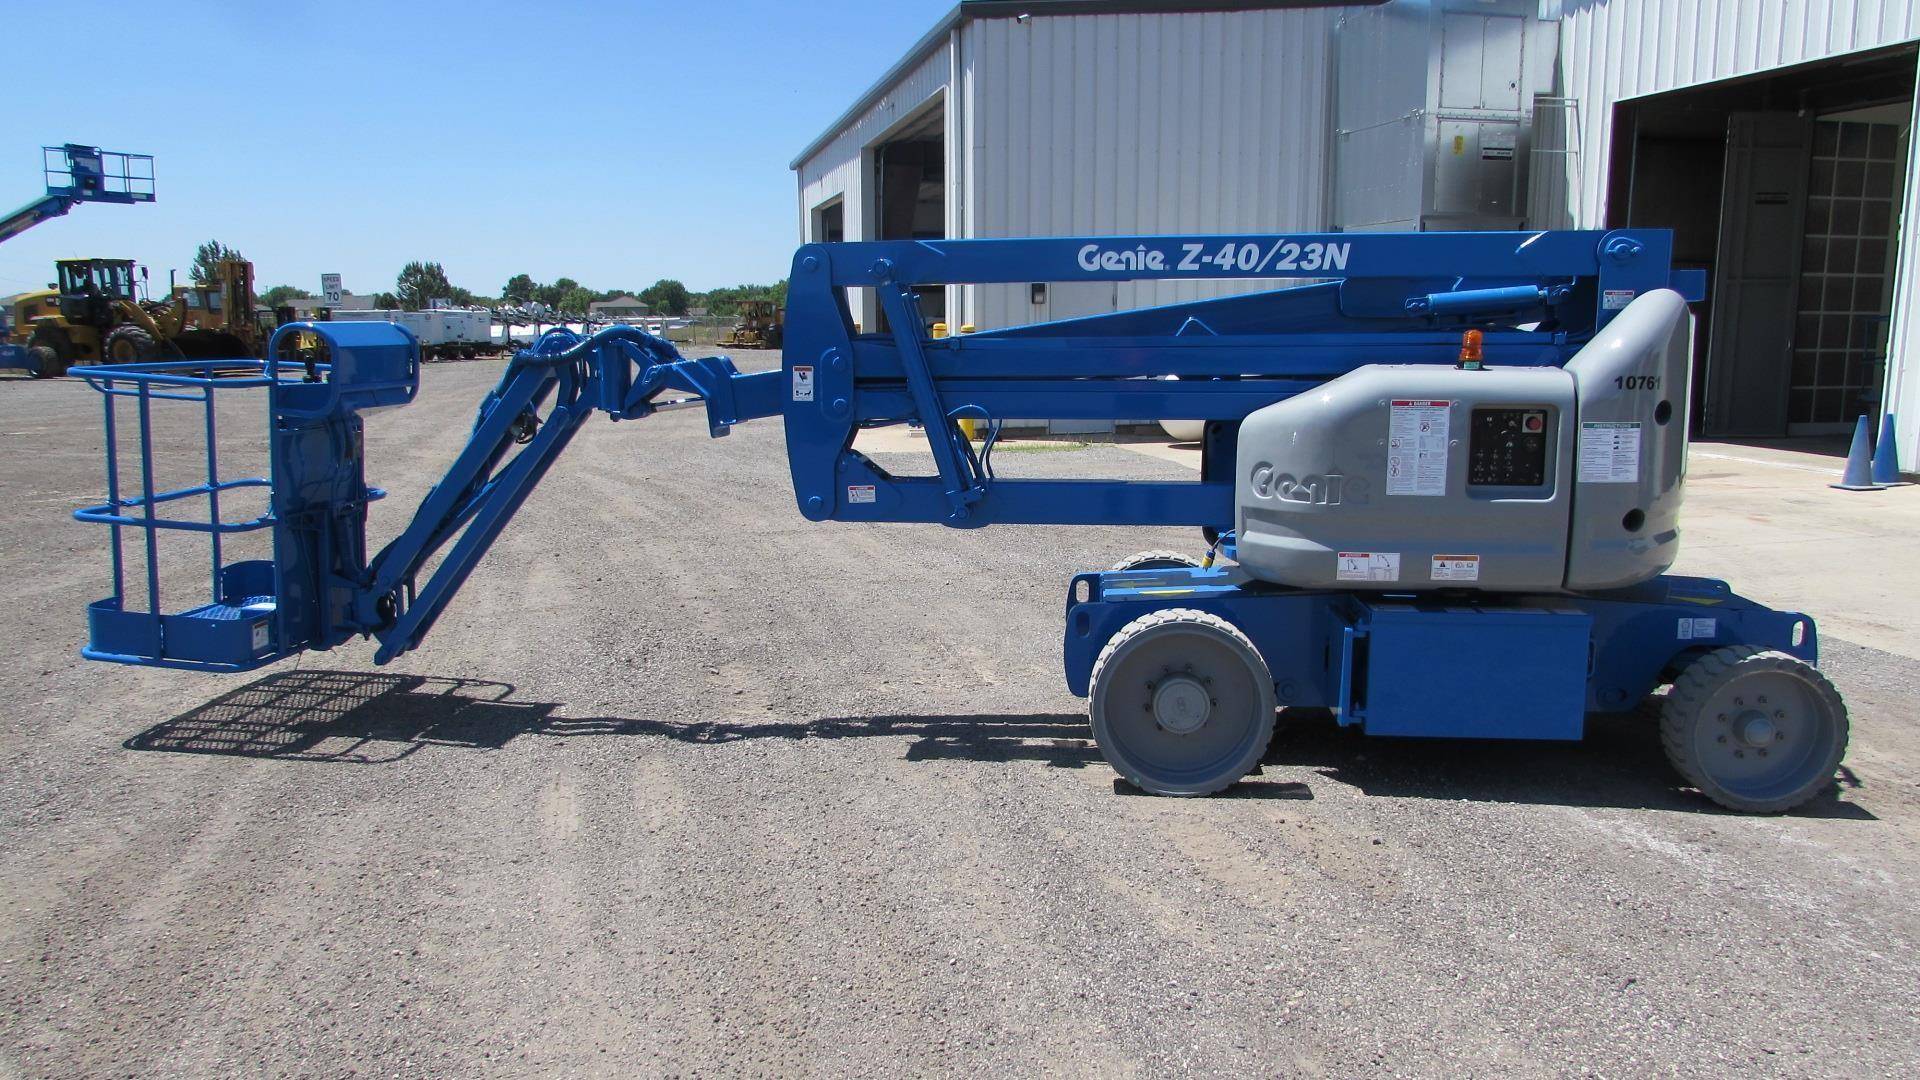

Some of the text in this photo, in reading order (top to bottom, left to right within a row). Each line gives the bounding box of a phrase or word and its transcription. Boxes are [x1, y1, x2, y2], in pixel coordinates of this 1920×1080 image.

[1177, 239, 1350, 272] Z-40/23N
[326, 292, 339, 301] 70
[1614, 375, 1661, 390] 10761
